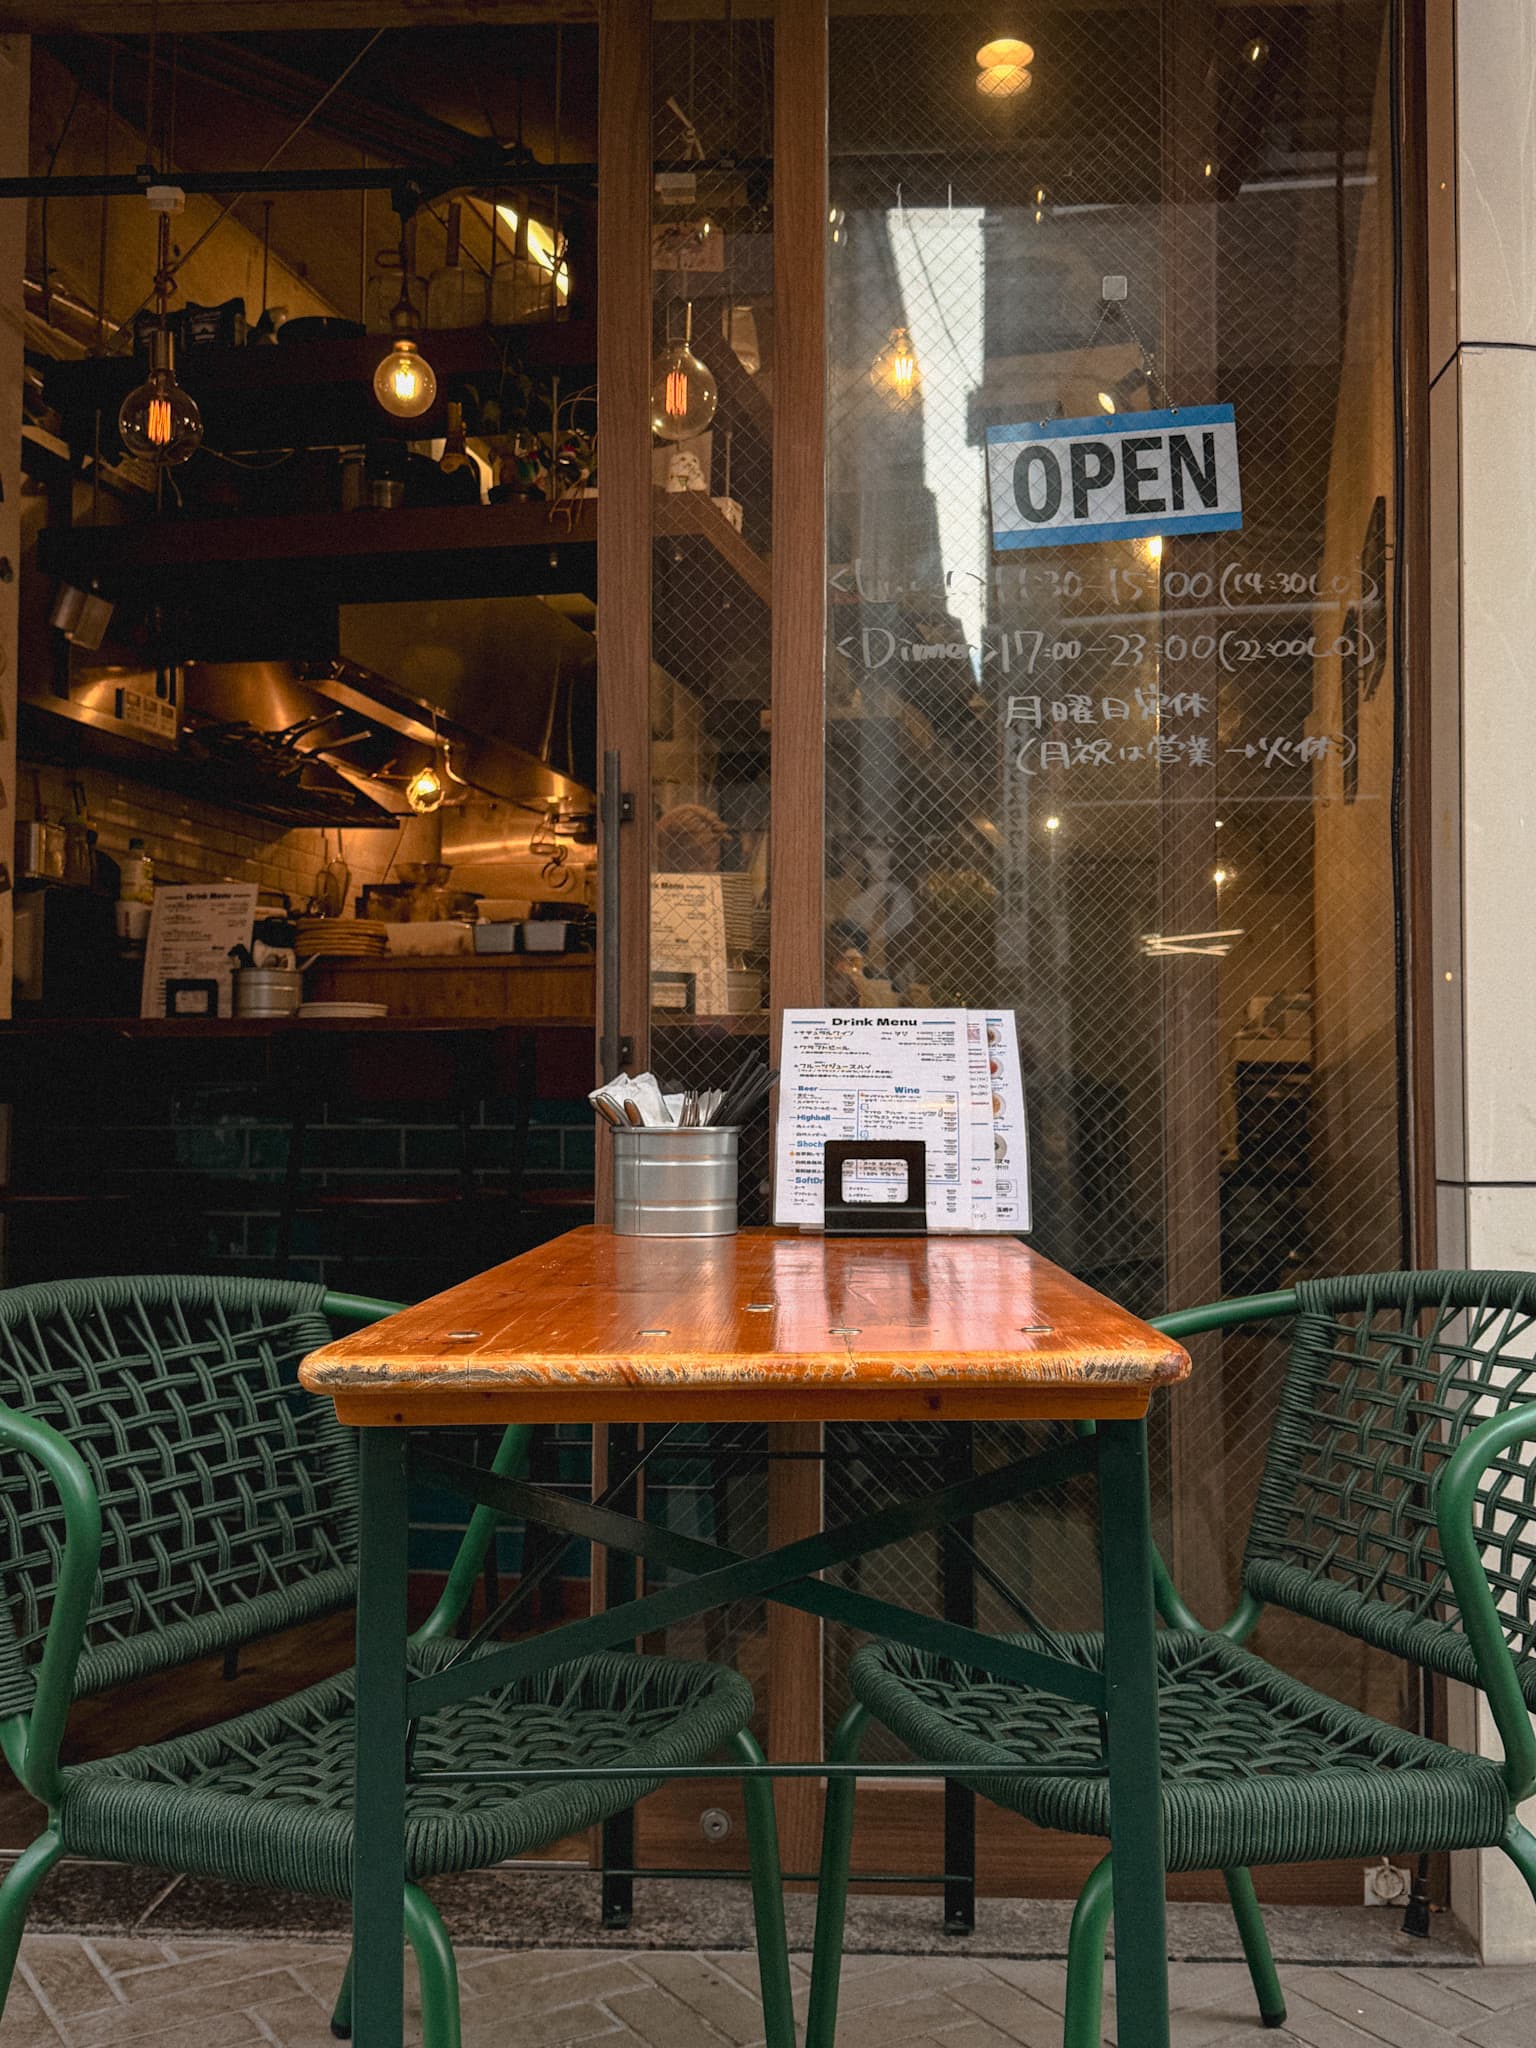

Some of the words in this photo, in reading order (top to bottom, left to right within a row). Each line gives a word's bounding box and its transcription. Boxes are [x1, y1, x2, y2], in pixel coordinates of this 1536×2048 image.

[1013, 432, 1219, 523] OPEN
[1004, 684, 1211, 730] 月曜日定休
[832, 1018, 873, 1026] Drink
[877, 1018, 918, 1026] Menu
[894, 1086, 920, 1094] Wine
[796, 1114, 831, 1122] Highball
[796, 1140, 824, 1148] Shoch
[795, 1177, 824, 1185] SoftDr
